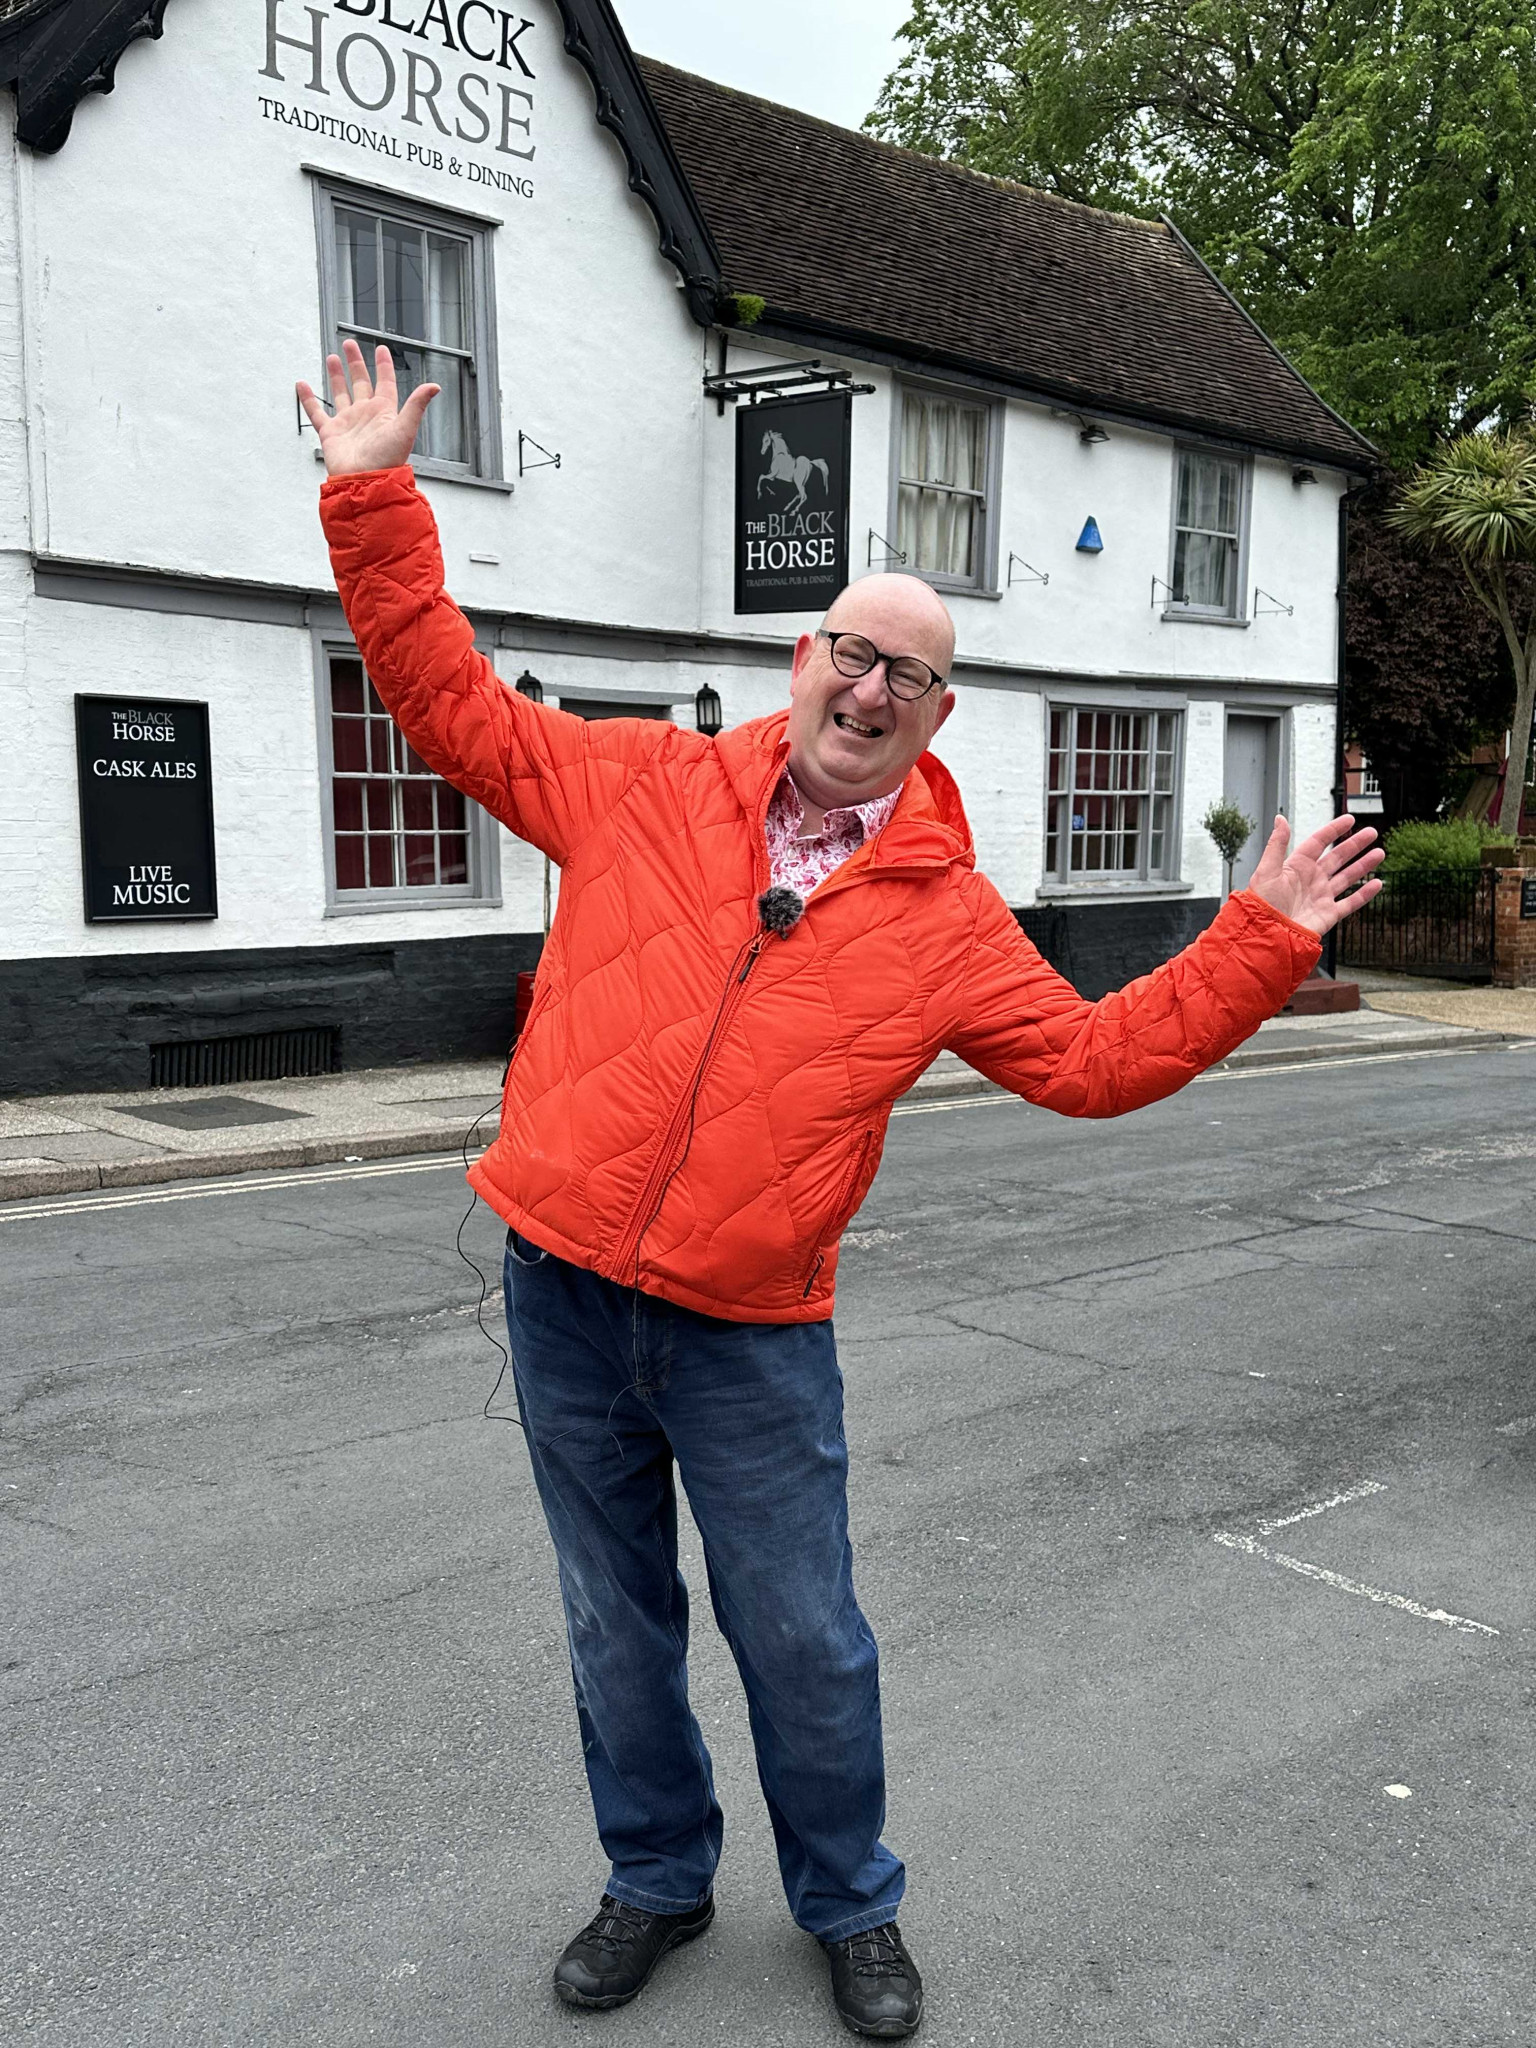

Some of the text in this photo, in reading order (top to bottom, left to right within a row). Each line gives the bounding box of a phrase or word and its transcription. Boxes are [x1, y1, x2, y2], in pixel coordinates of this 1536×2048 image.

[334, 0, 536, 79] LACK
[258, 0, 536, 161] HORSE
[258, 96, 534, 199] TRADITIONAL PUB & DINING
[745, 511, 835, 538] THE BLACK
[745, 538, 836, 571] HORSE
[111, 709, 174, 726] THE BLACK
[112, 722, 175, 742] HORSE
[93, 758, 197, 779] CASK ALES
[129, 865, 172, 883] LIVE
[112, 883, 190, 905] MUSIC
